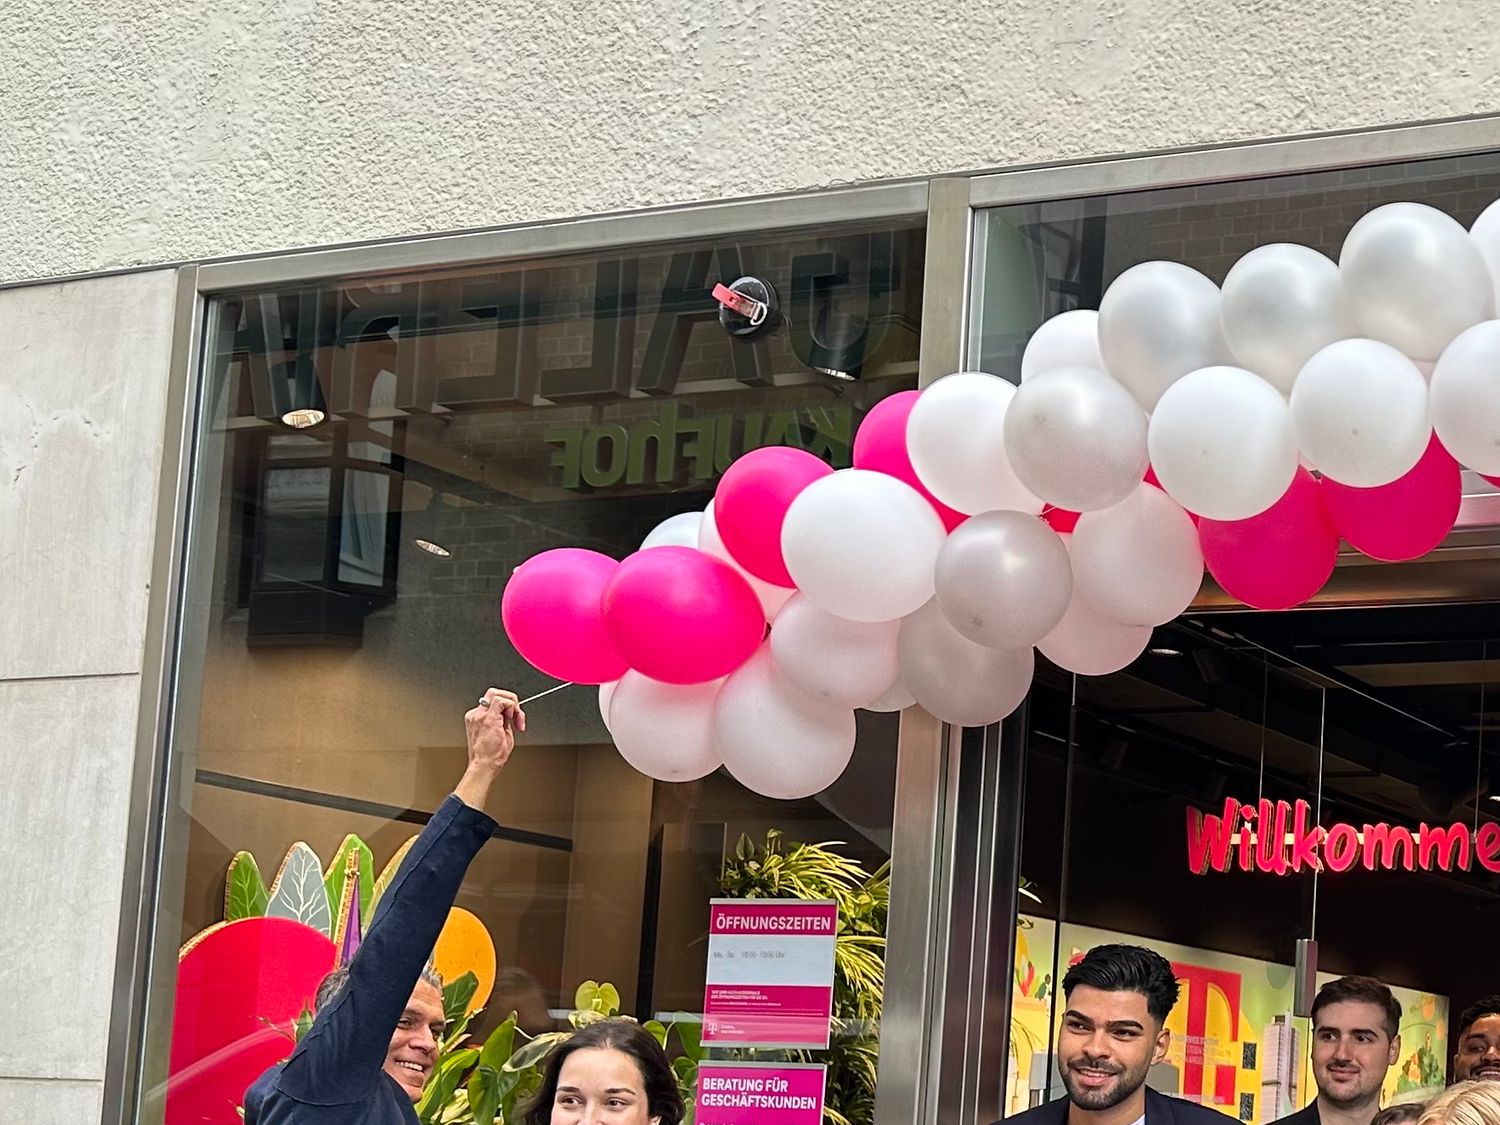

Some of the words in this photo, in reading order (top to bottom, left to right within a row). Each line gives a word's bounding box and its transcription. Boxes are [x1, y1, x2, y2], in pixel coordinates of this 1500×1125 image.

[716, 913, 831, 930] ÖFFNUNGSZEITEN
[703, 1077, 763, 1092] BERATUNG
[765, 1076, 788, 1093] FÜR
[701, 1091, 816, 1110] GESCHÄFTSKUNDEN
